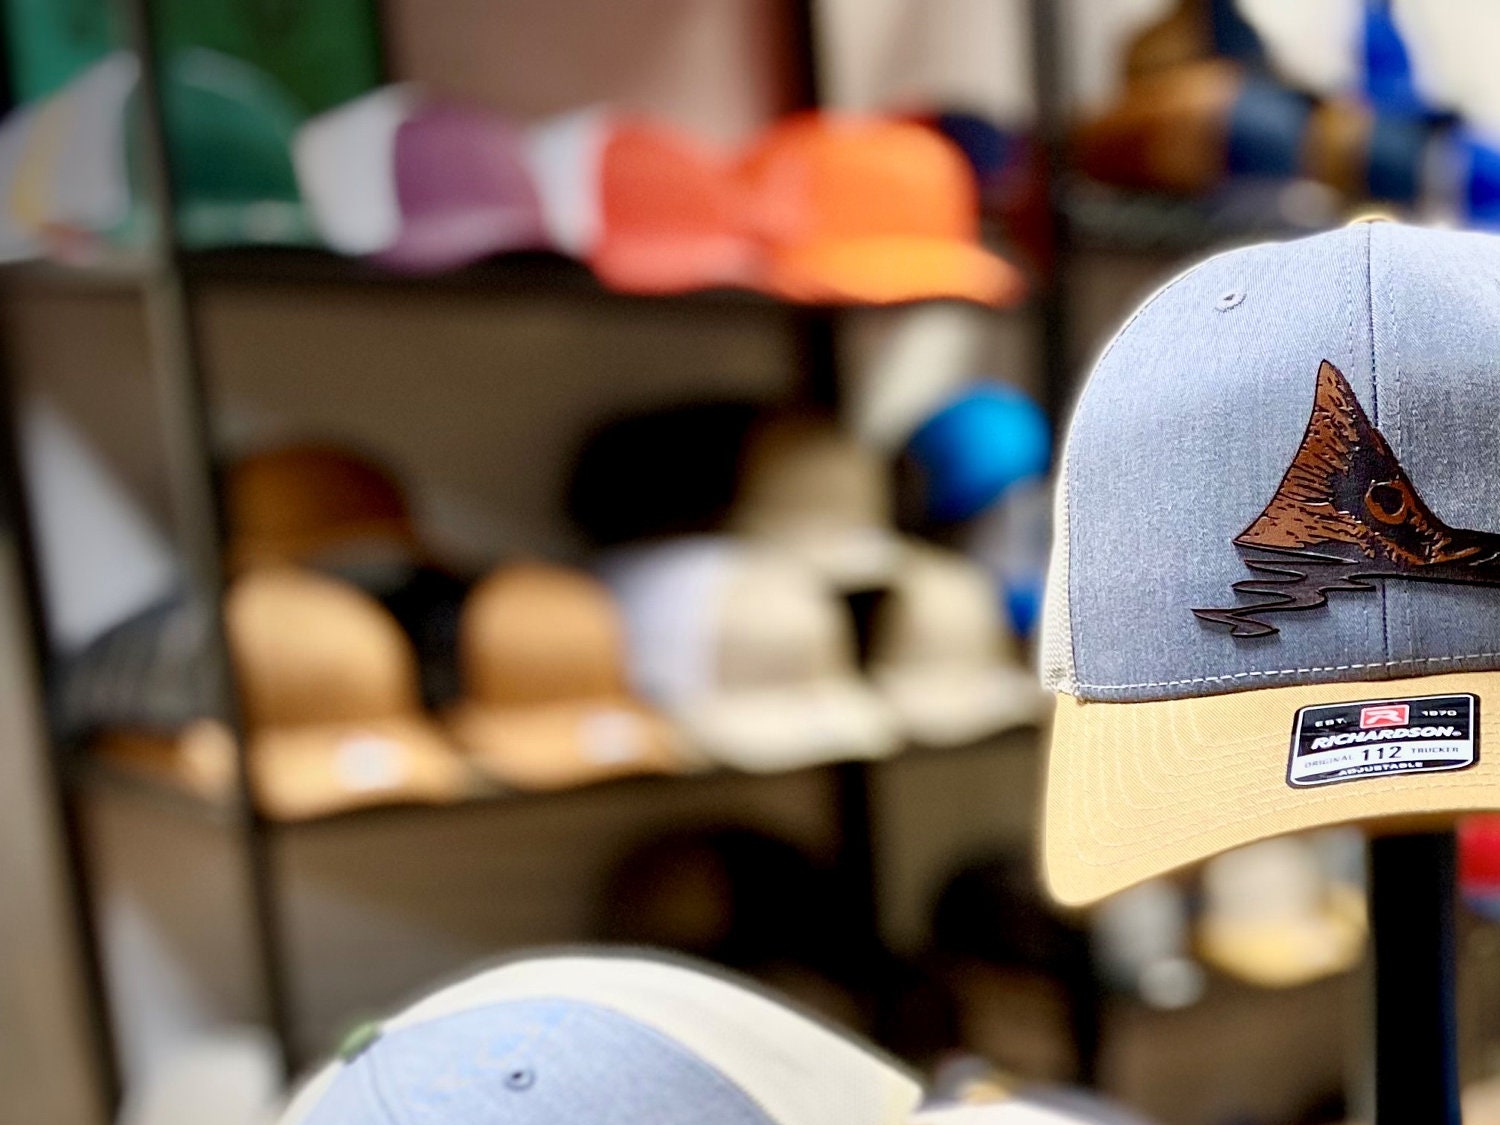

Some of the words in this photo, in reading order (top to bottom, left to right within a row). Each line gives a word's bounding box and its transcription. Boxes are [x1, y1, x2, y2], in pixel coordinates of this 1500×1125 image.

[1311, 725, 1455, 750] RICHARDSON
[1304, 754, 1353, 768] ORIGINAL
[1361, 745, 1402, 761] 112
[1411, 746, 1459, 754] TRUCKER
[1338, 761, 1424, 776] ADJUSTABLE
